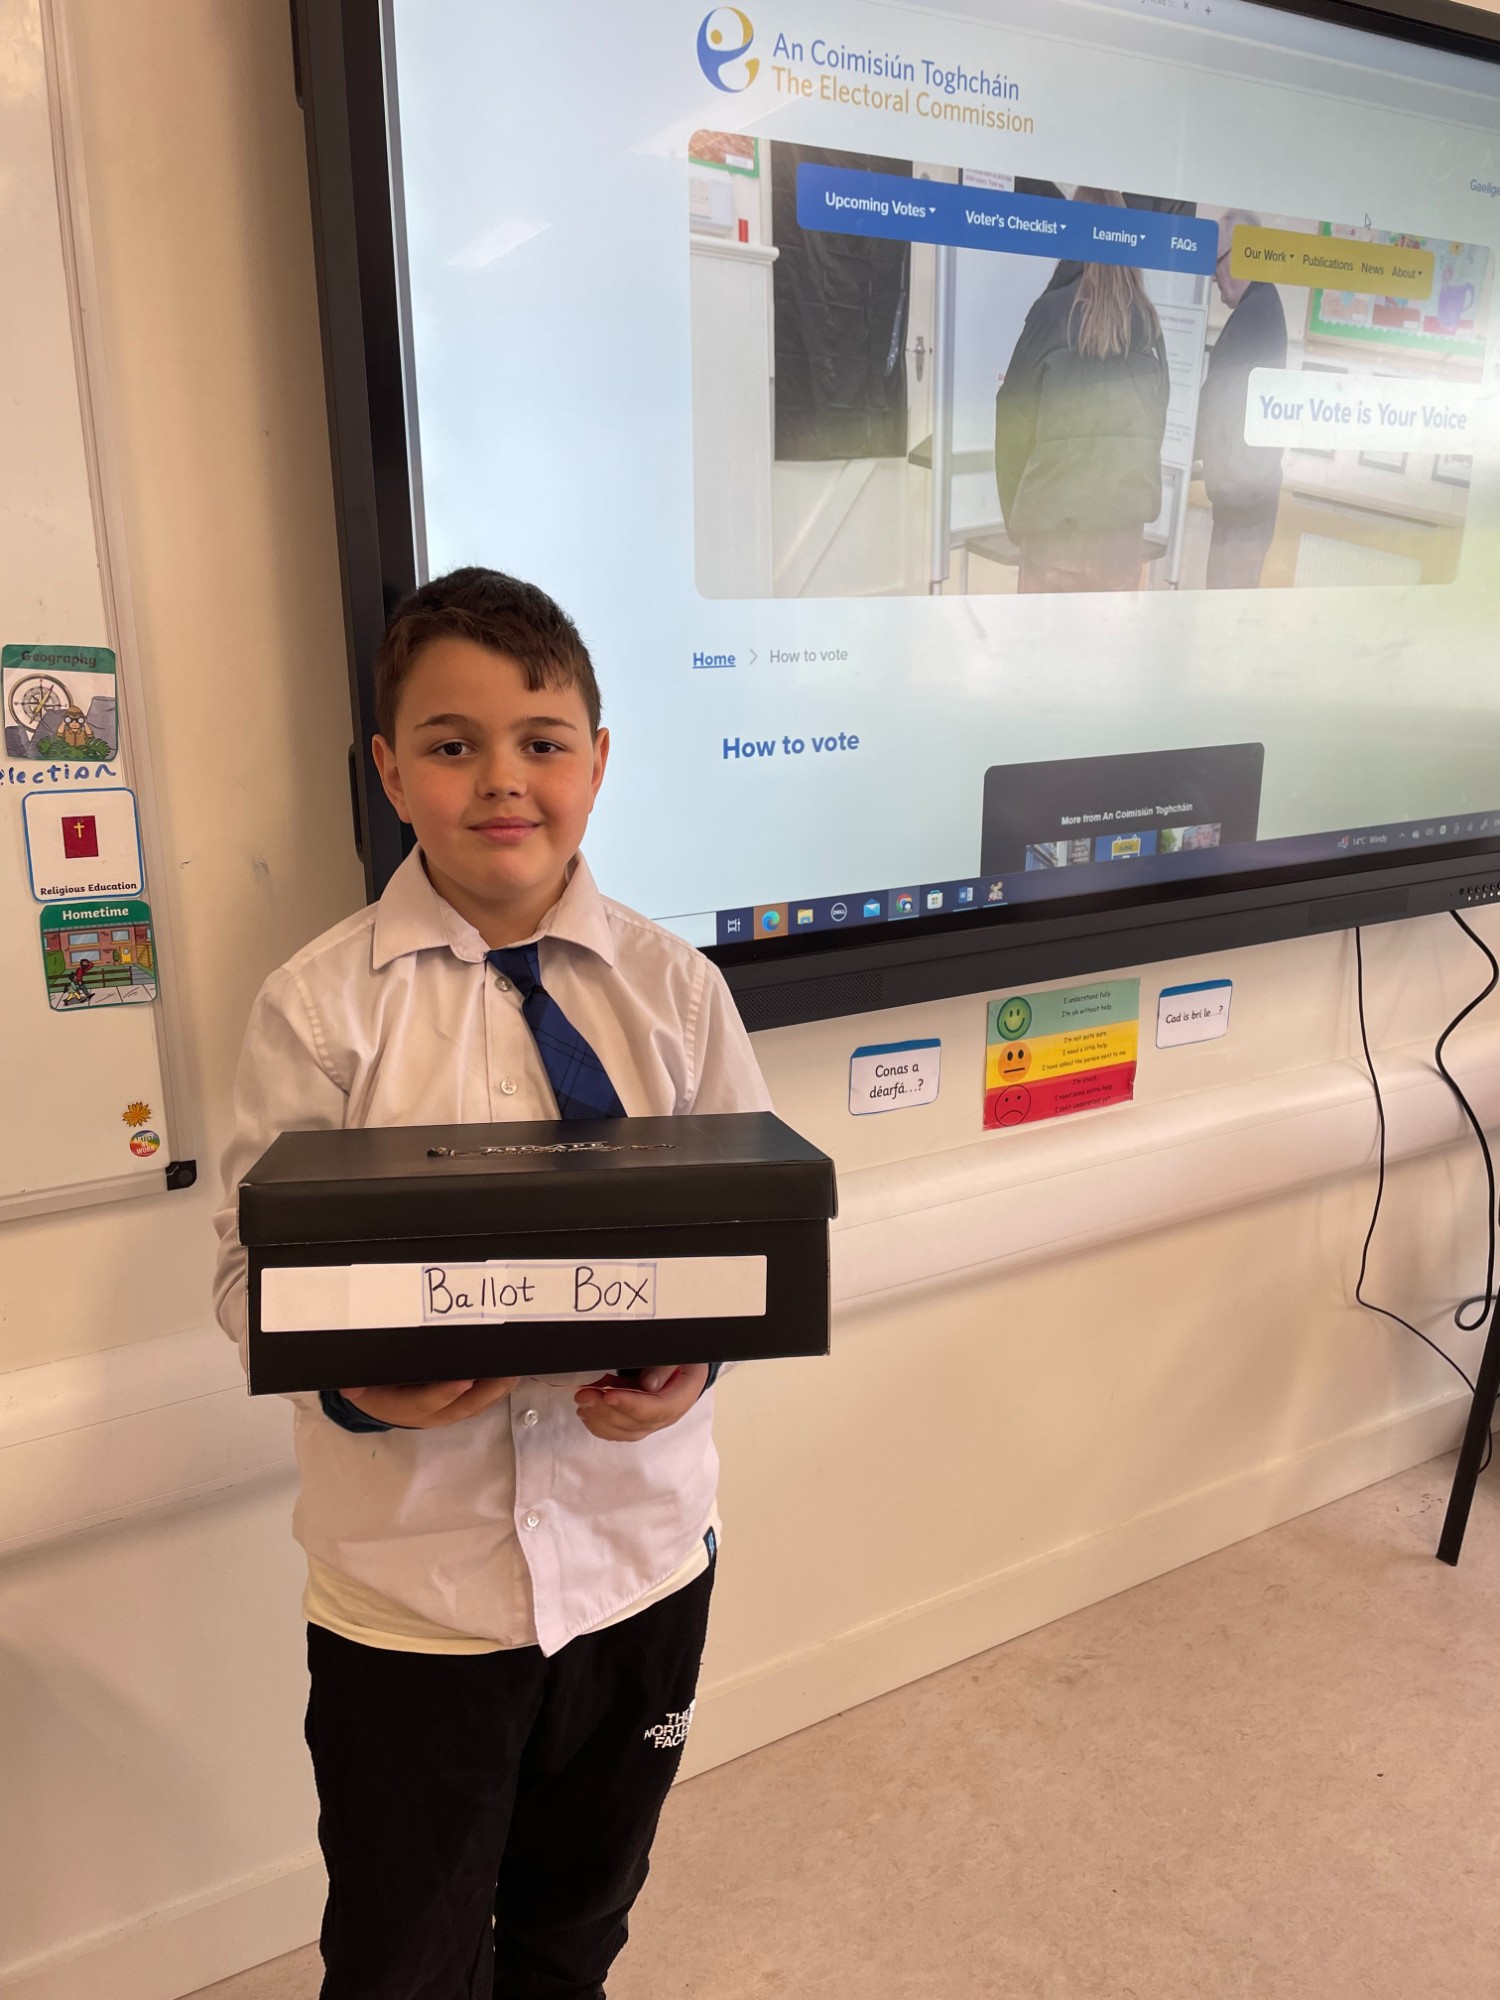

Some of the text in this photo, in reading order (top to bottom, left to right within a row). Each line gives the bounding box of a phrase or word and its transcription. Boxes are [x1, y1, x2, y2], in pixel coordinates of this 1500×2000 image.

[773, 33, 1020, 101] An Coimisiún Toghcháin
[771, 66, 1034, 134] The Electoral Commission
[825, 192, 1197, 252] Upcoming Votes Voter's Checklist Learning FAQs
[1244, 247, 1416, 279] Our Work Publications News About
[1260, 395, 1467, 430] Your Vote is Your Voice
[22, 651, 97, 668] Geography
[693, 648, 848, 668] Home How to vote
[723, 732, 860, 759] How to vote
[1061, 816, 1081, 825] More
[1083, 814, 1101, 823] from
[1102, 812, 1114, 821] An
[41, 882, 137, 896] Religious Education
[62, 907, 129, 920] Hometime
[1165, 1012, 1181, 1023] Cad
[1183, 1012, 1189, 1020] is
[875, 1064, 919, 1078] Conas a
[133, 1133, 154, 1143] ARTIST
[425, 1266, 649, 1314] Ballot Box
